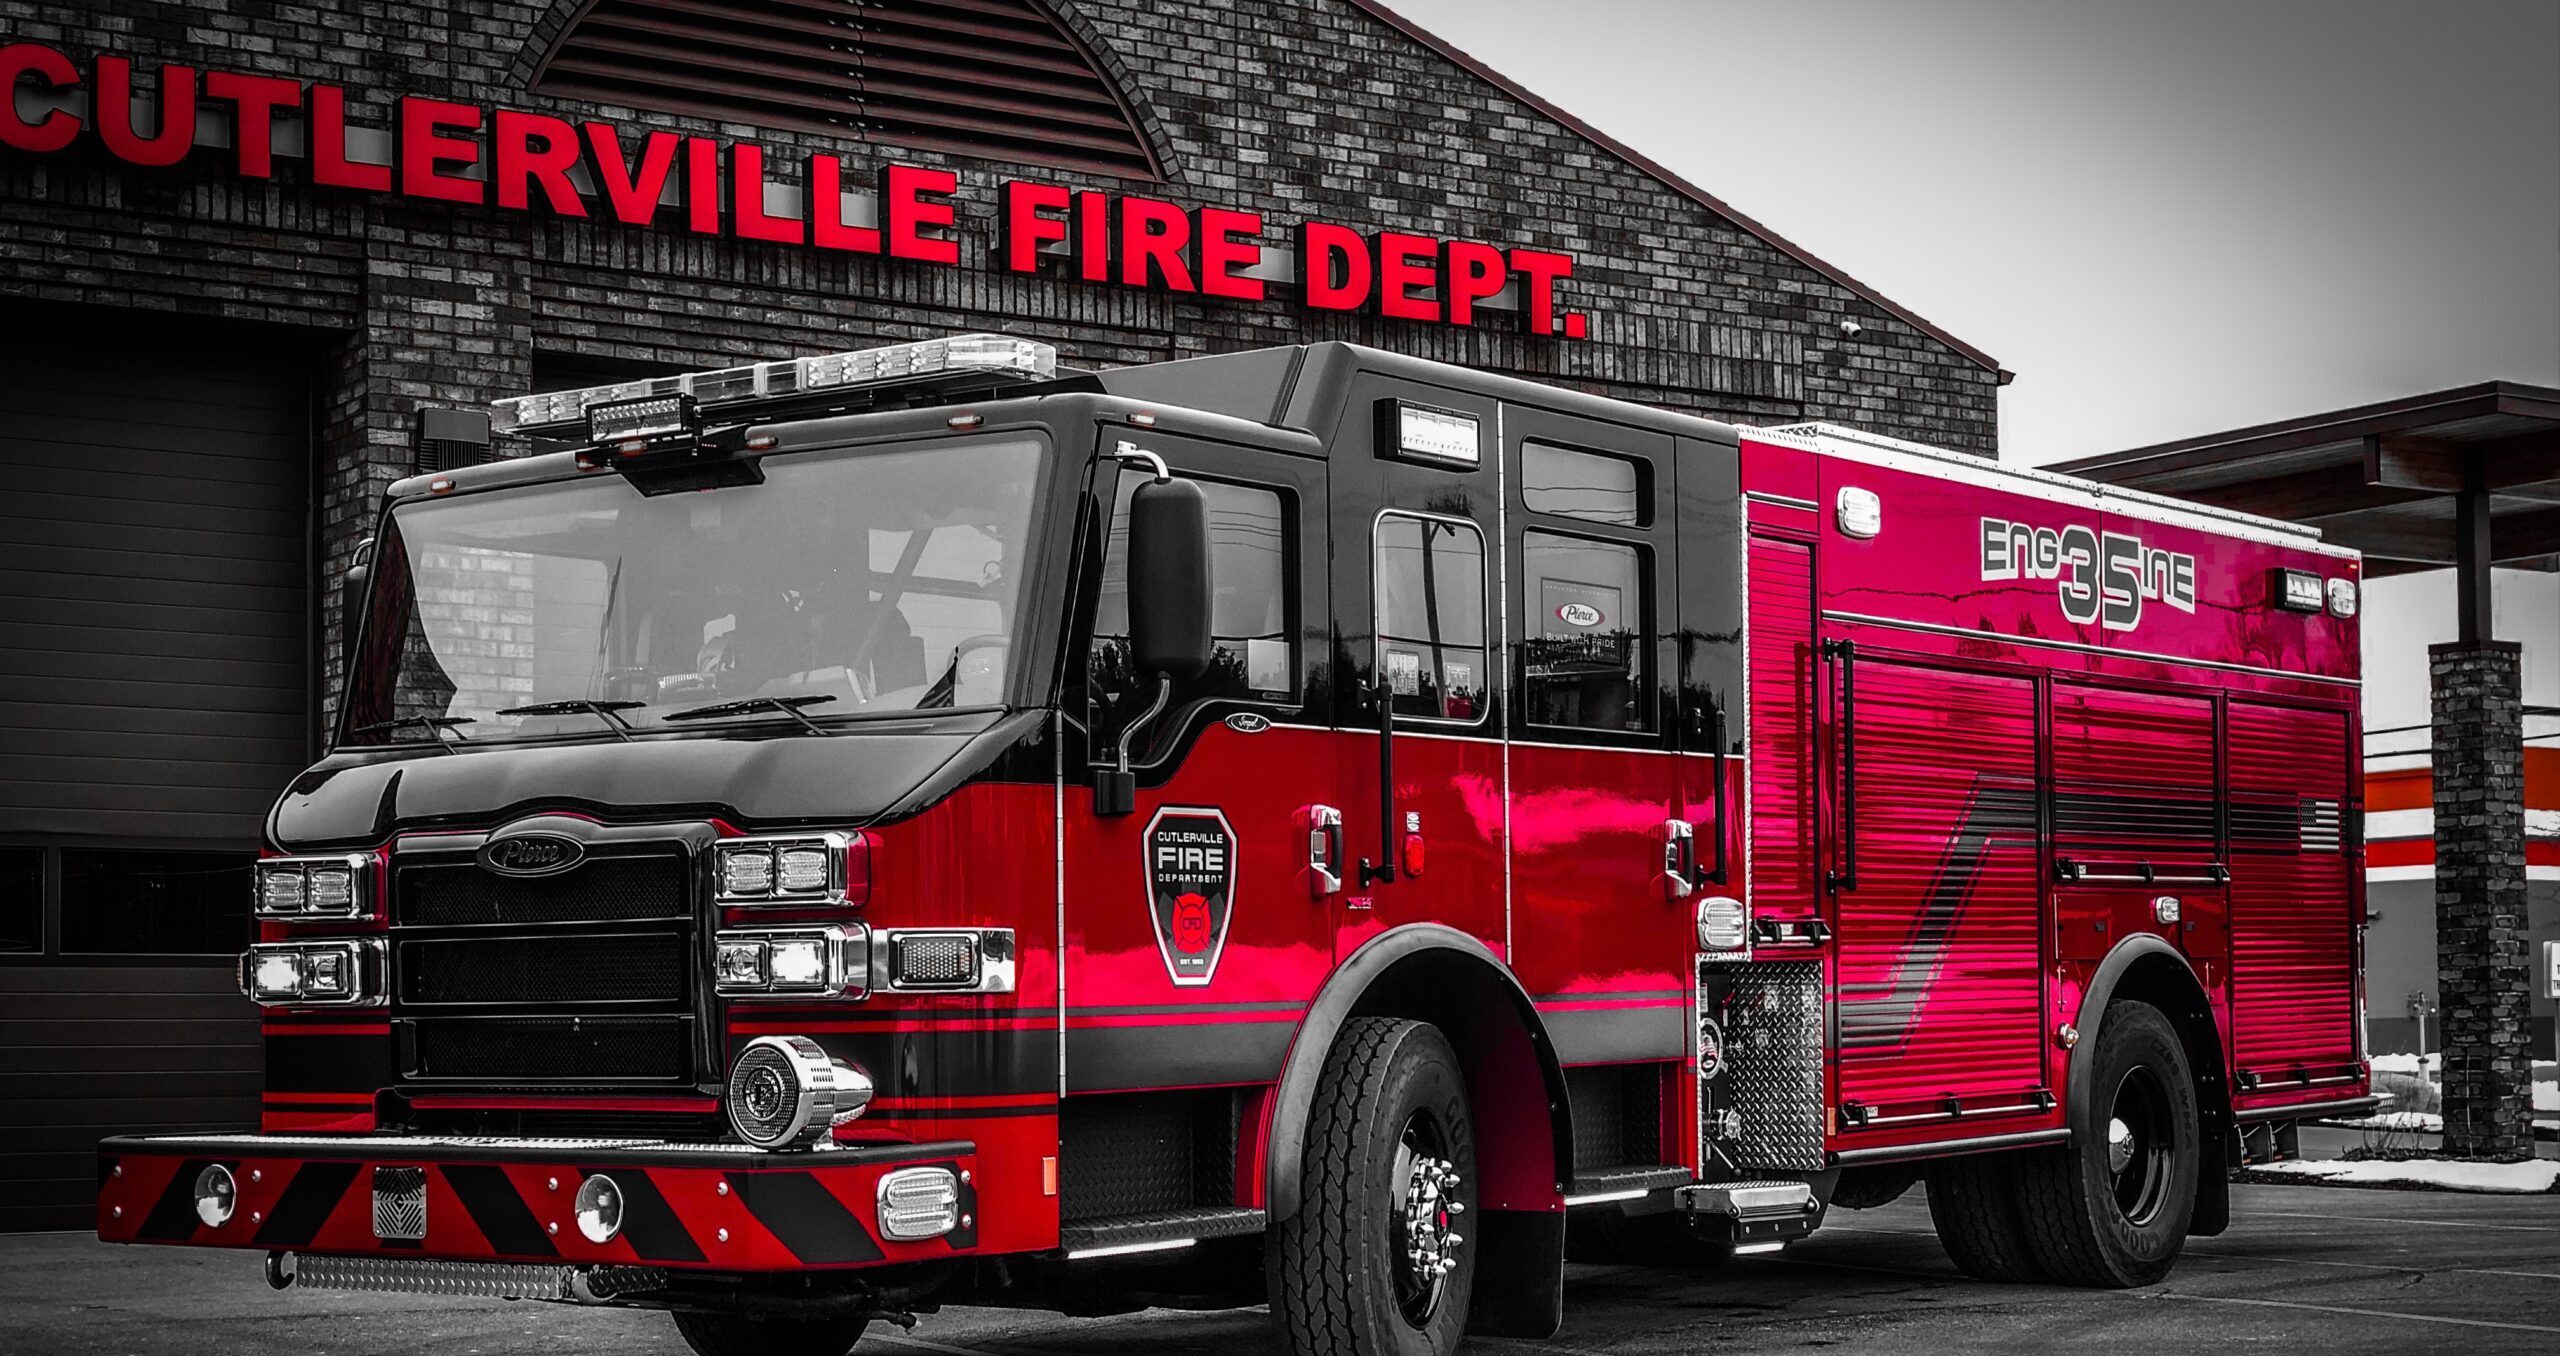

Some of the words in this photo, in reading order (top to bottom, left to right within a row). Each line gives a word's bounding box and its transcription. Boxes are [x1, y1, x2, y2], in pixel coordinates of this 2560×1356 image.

[0, 43, 959, 266] CUTLERVILLE
[1004, 180, 1265, 301] FIRE
[1298, 220, 1587, 340] DEPT.
[2058, 524, 2142, 632] 35
[1566, 605, 1594, 622] Pierce
[1546, 632, 1568, 643] BUILT
[1591, 637, 1616, 649] PRIDE
[1157, 831, 1223, 844] CUTLERVILLE
[503, 840, 560, 867] Pierce
[1157, 847, 1223, 871] FIRE
[1158, 873, 1223, 884] DEPARTMENT
